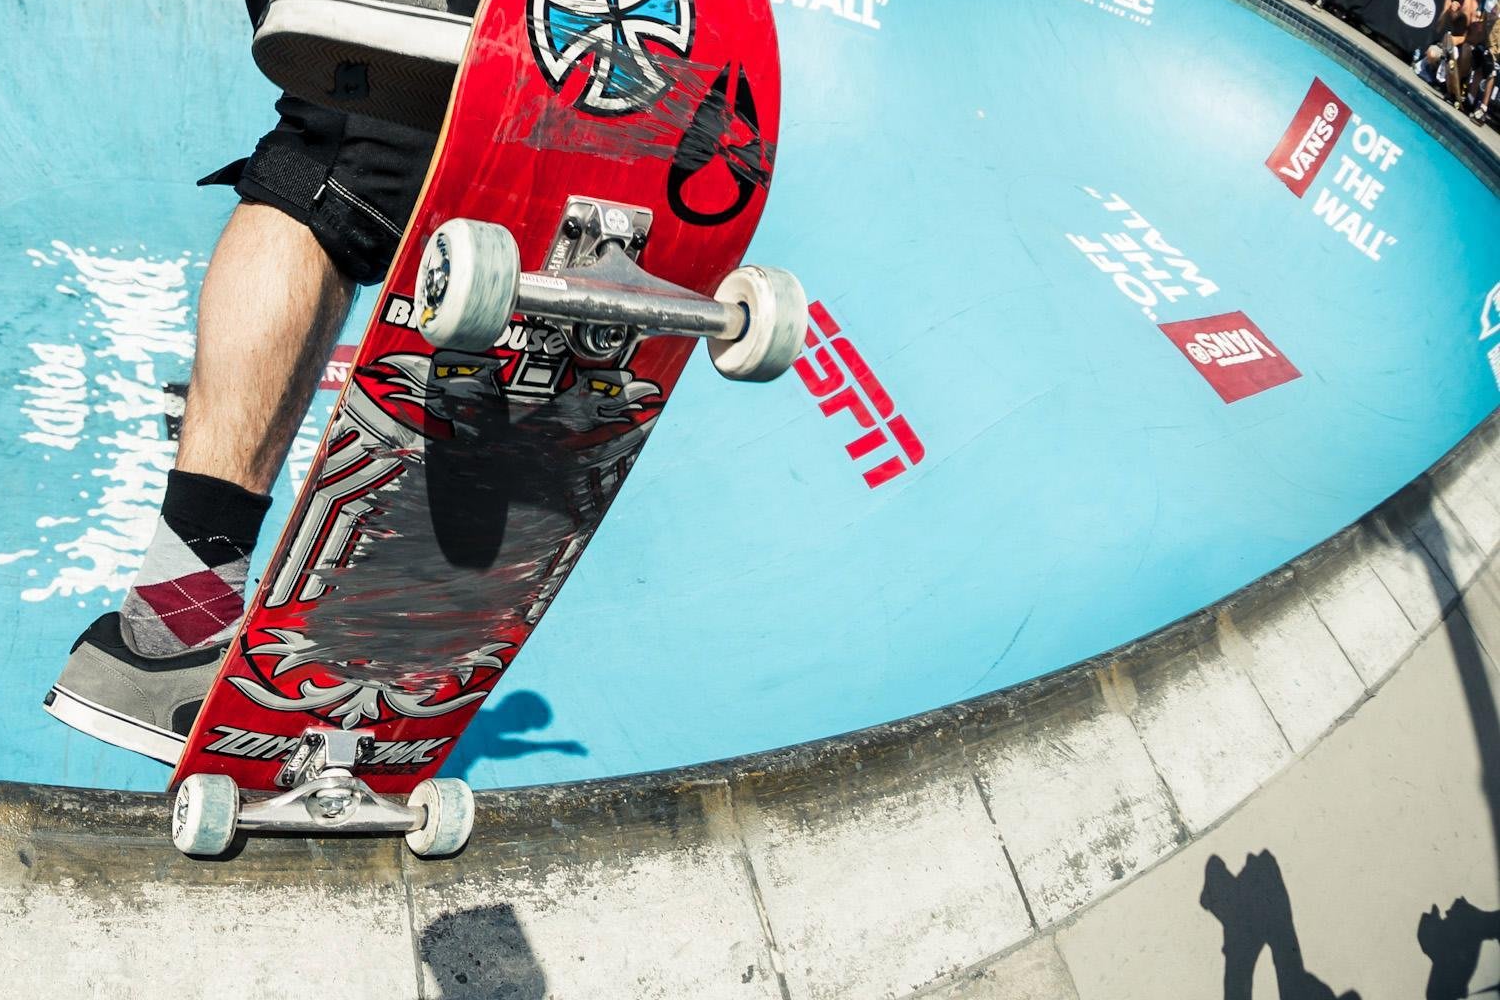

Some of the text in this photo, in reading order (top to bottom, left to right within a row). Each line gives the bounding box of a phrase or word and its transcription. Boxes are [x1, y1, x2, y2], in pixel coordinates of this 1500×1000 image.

[1332, 154, 1386, 211] THE
[1101, 232, 1190, 304] THE
[14, 341, 90, 450] BONDI
